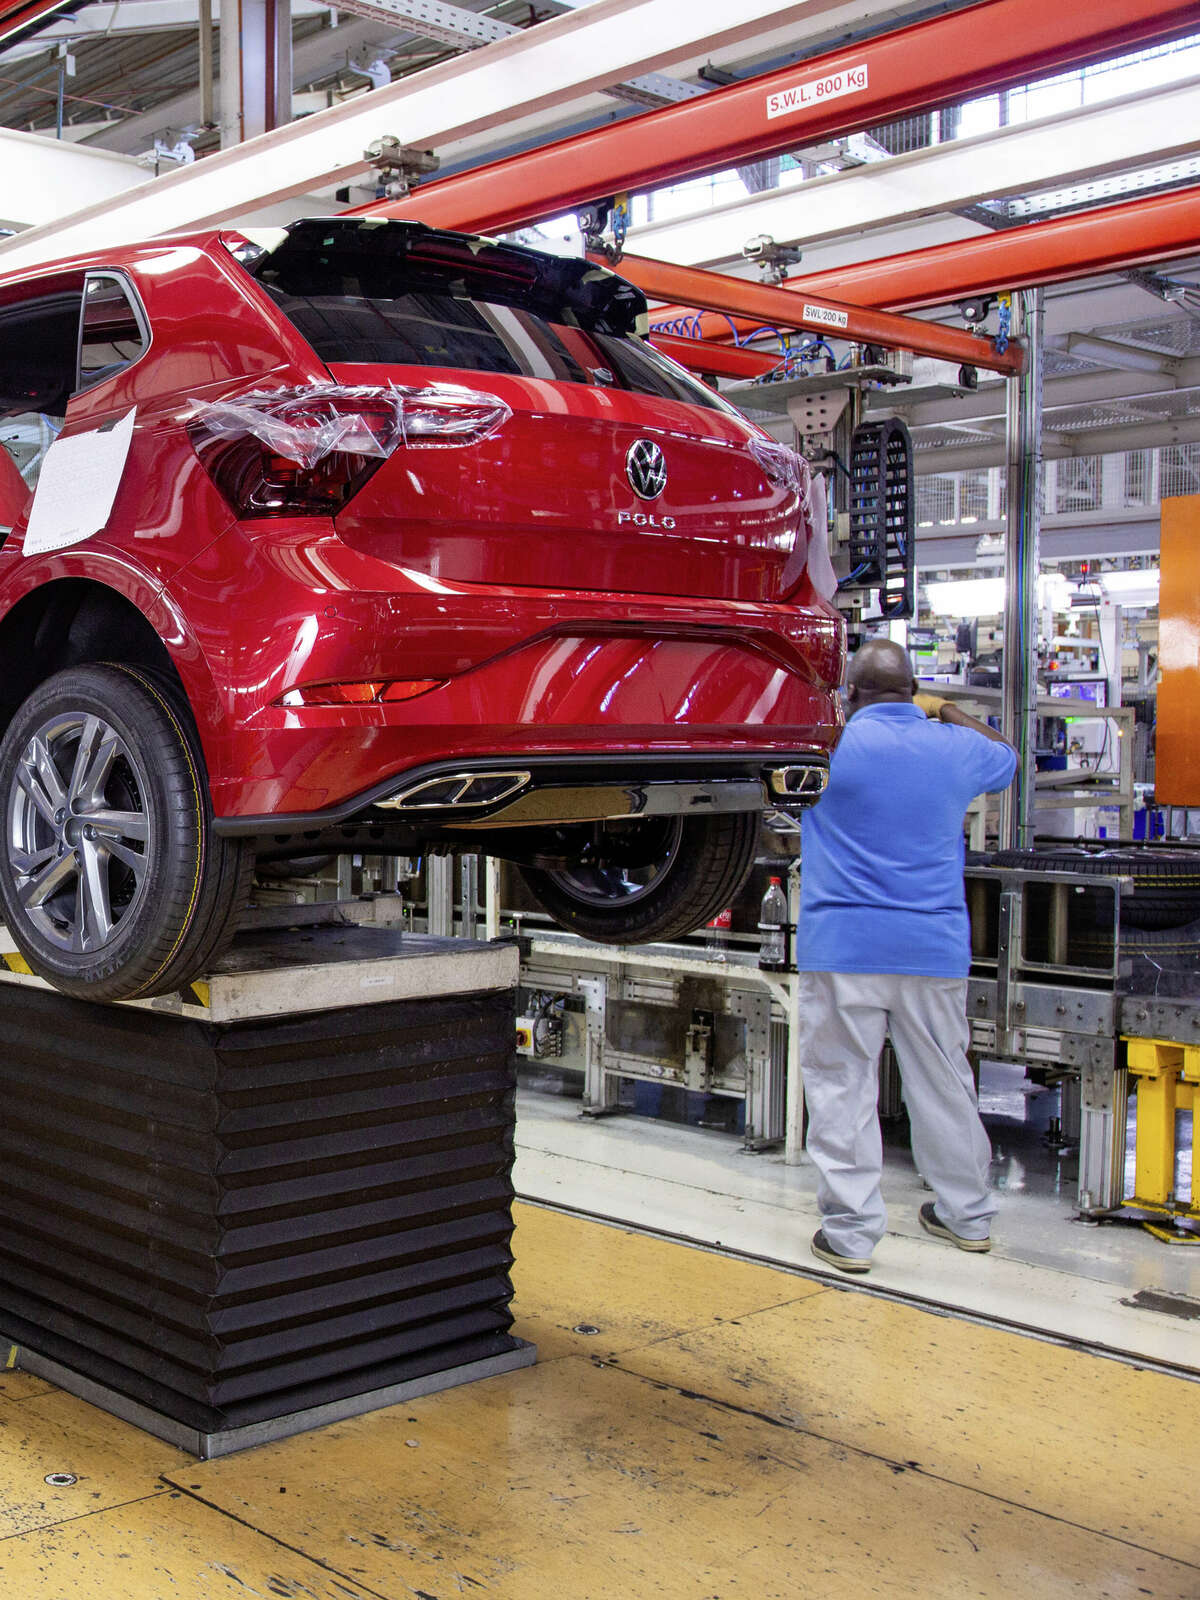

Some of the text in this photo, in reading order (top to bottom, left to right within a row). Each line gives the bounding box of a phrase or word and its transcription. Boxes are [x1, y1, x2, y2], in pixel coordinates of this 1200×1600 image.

[770, 70, 865, 112] S.W.L. 800 Kg
[805, 306, 821, 319] SWL
[823, 311, 837, 322] 200
[617, 511, 676, 530] POLO
